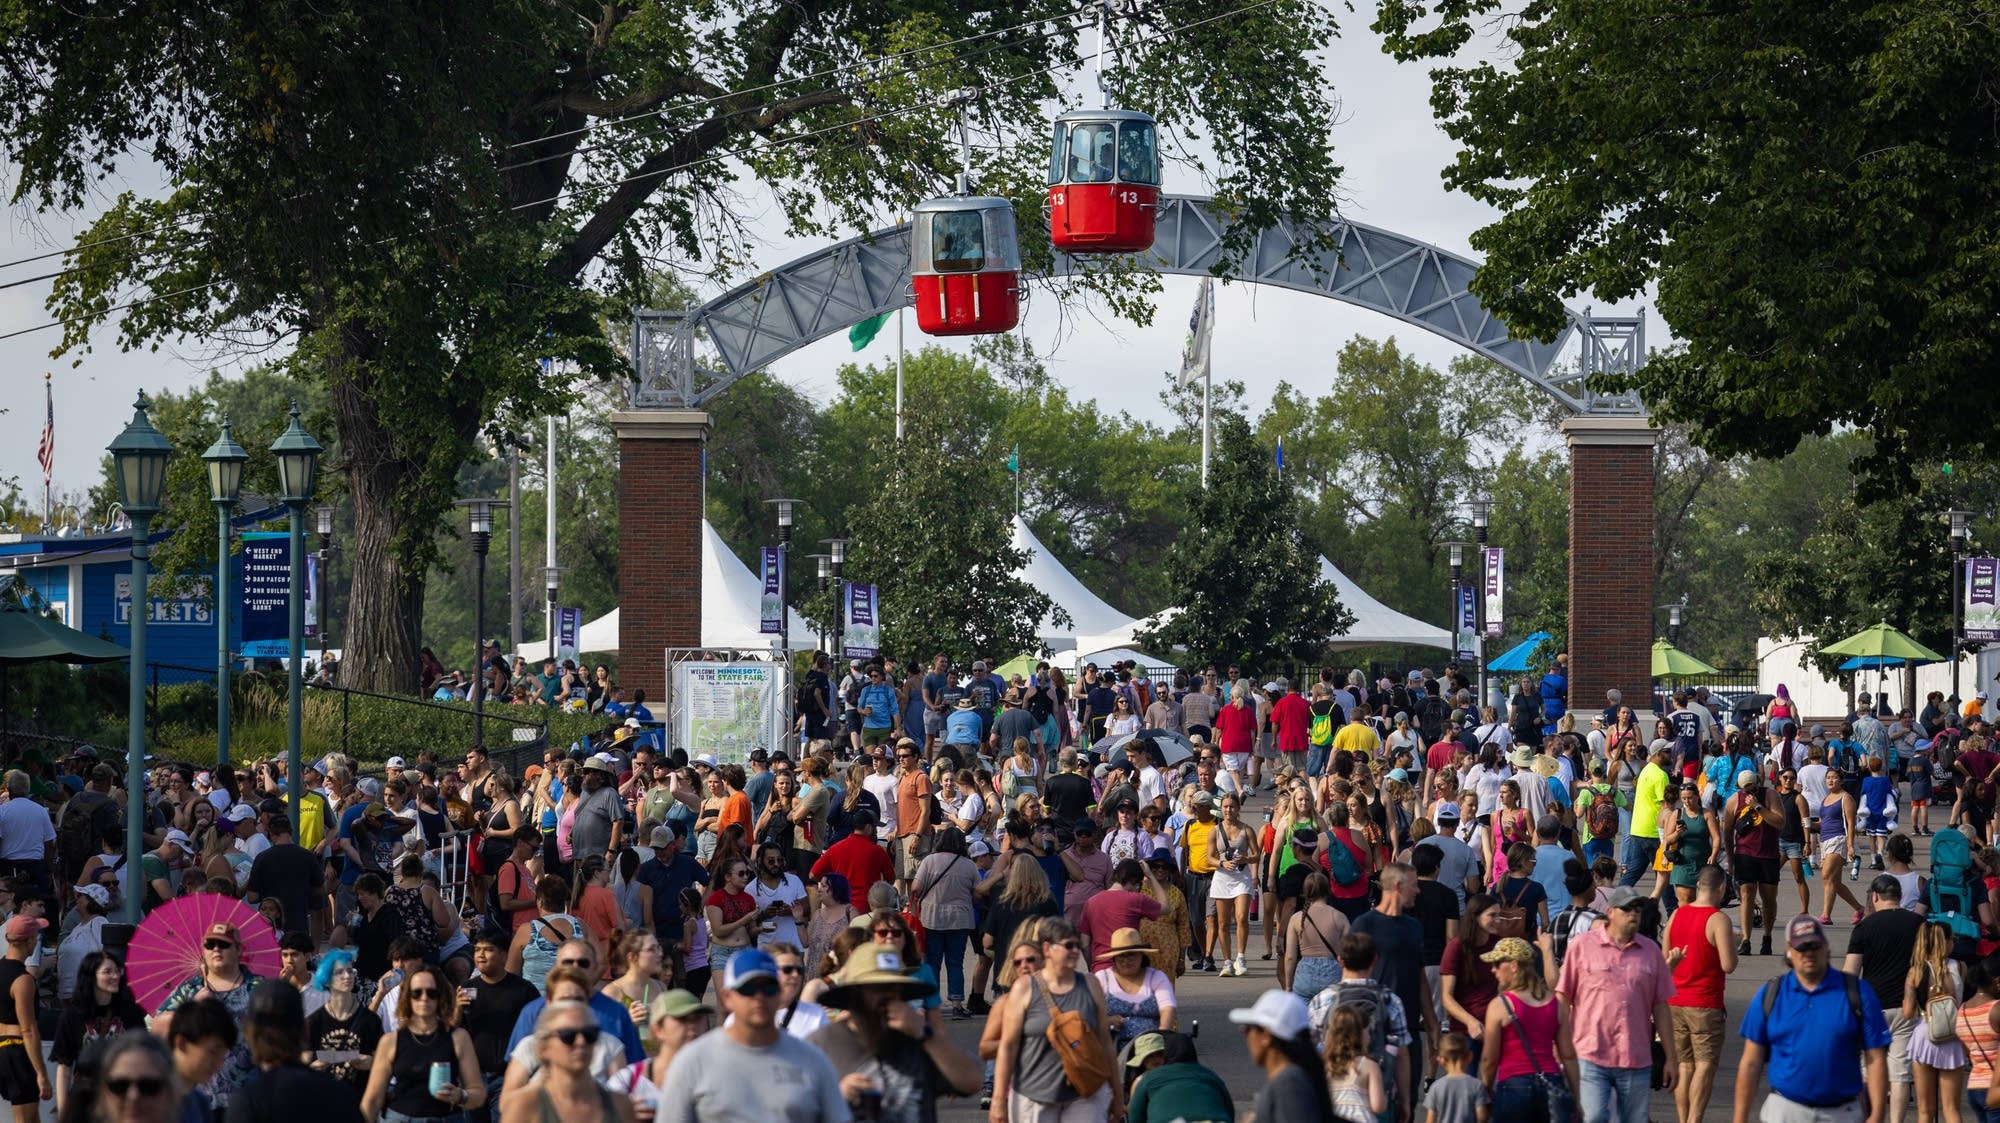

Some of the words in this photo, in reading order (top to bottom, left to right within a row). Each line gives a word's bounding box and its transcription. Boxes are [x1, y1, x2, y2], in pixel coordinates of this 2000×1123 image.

[1052, 192, 1064, 206] 13
[1120, 191, 1138, 204] 13
[118, 602, 208, 622] TCKETS
[1678, 721, 1695, 737] 36
